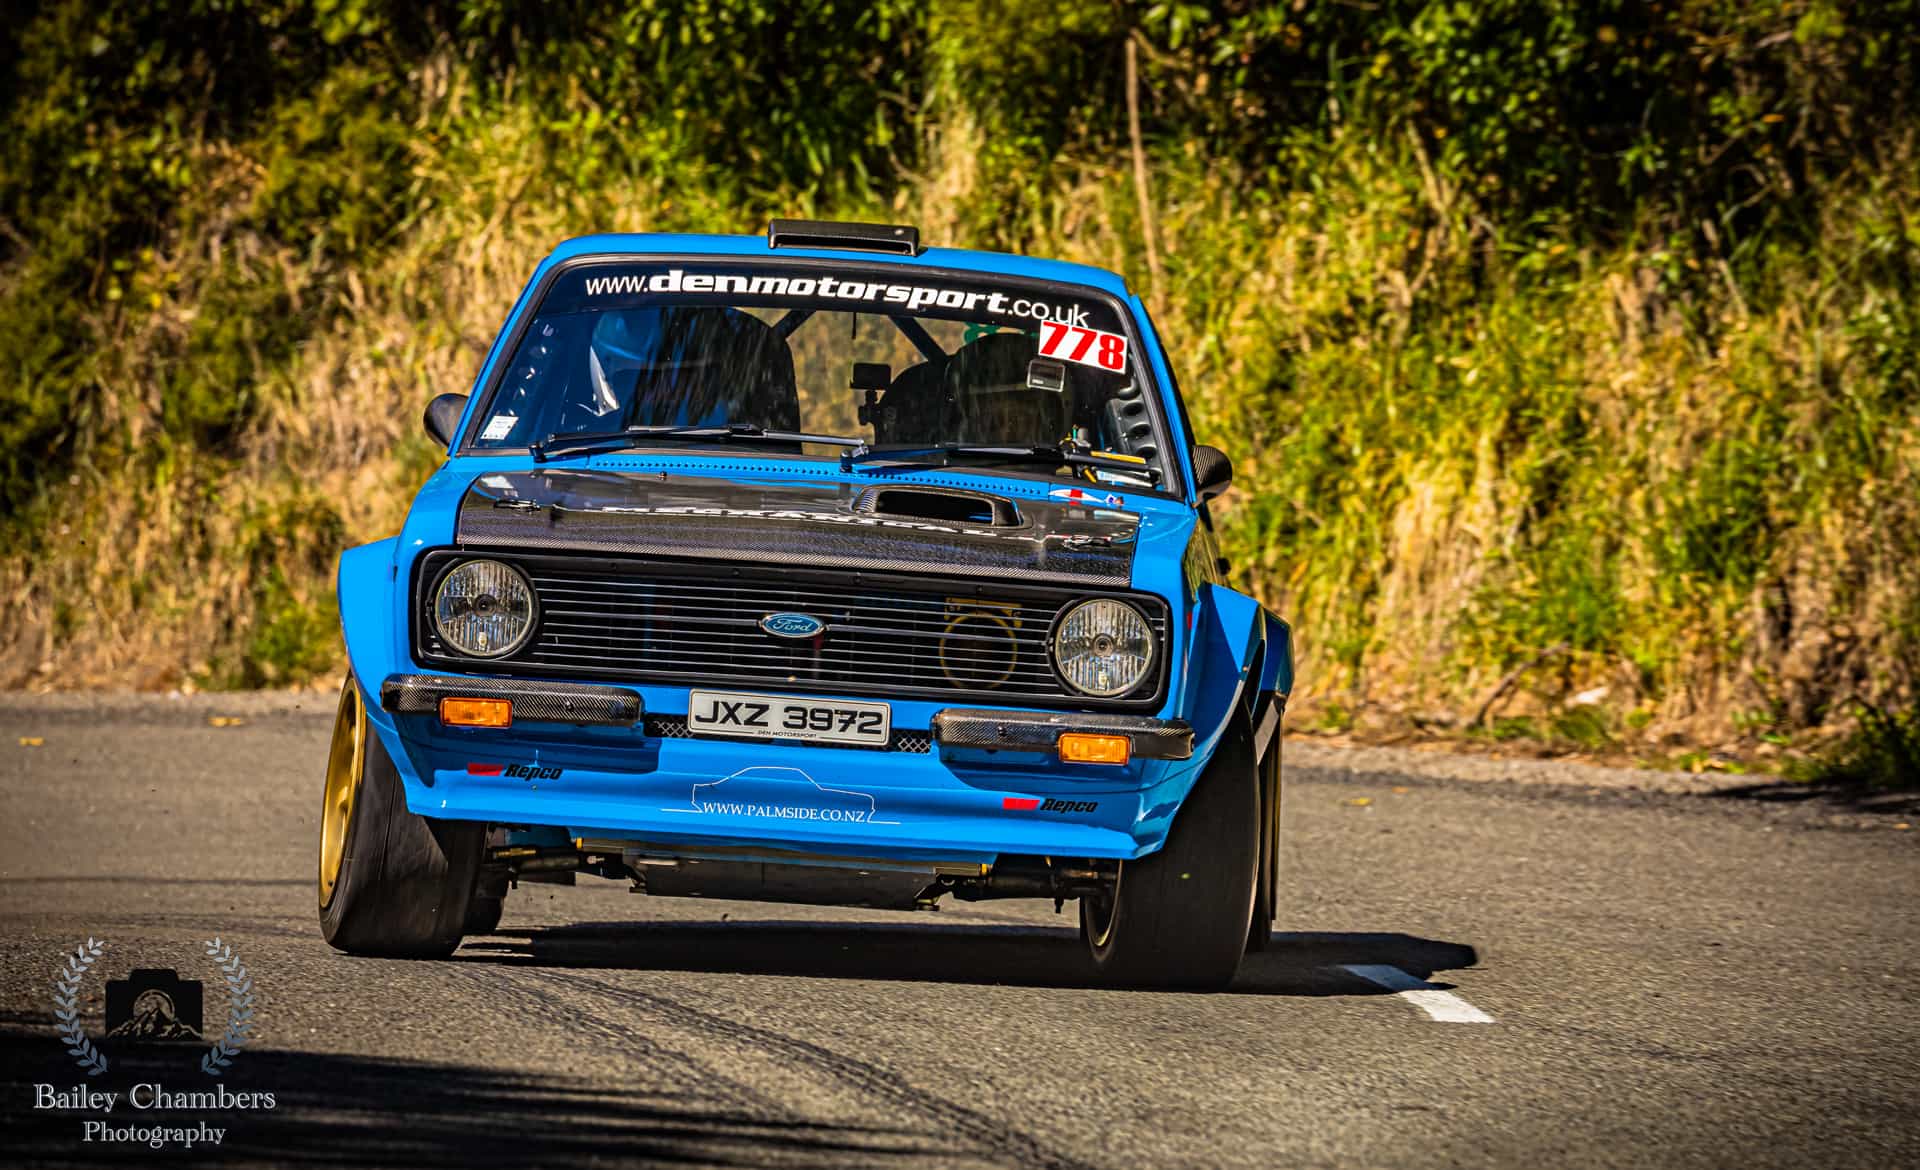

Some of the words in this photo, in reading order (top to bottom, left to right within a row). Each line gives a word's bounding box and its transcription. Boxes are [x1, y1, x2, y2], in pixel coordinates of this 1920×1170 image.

[585, 269, 1090, 328] www.denmotorsport.co.uk
[1039, 320, 1126, 371] 778
[772, 618, 812, 632] Ford
[695, 701, 770, 727] JXZ
[782, 705, 883, 735] 3972
[504, 763, 563, 781] Repco
[703, 801, 865, 823] WWW.PALMSIDE.CO.NZ
[1040, 798, 1098, 814] Repco
